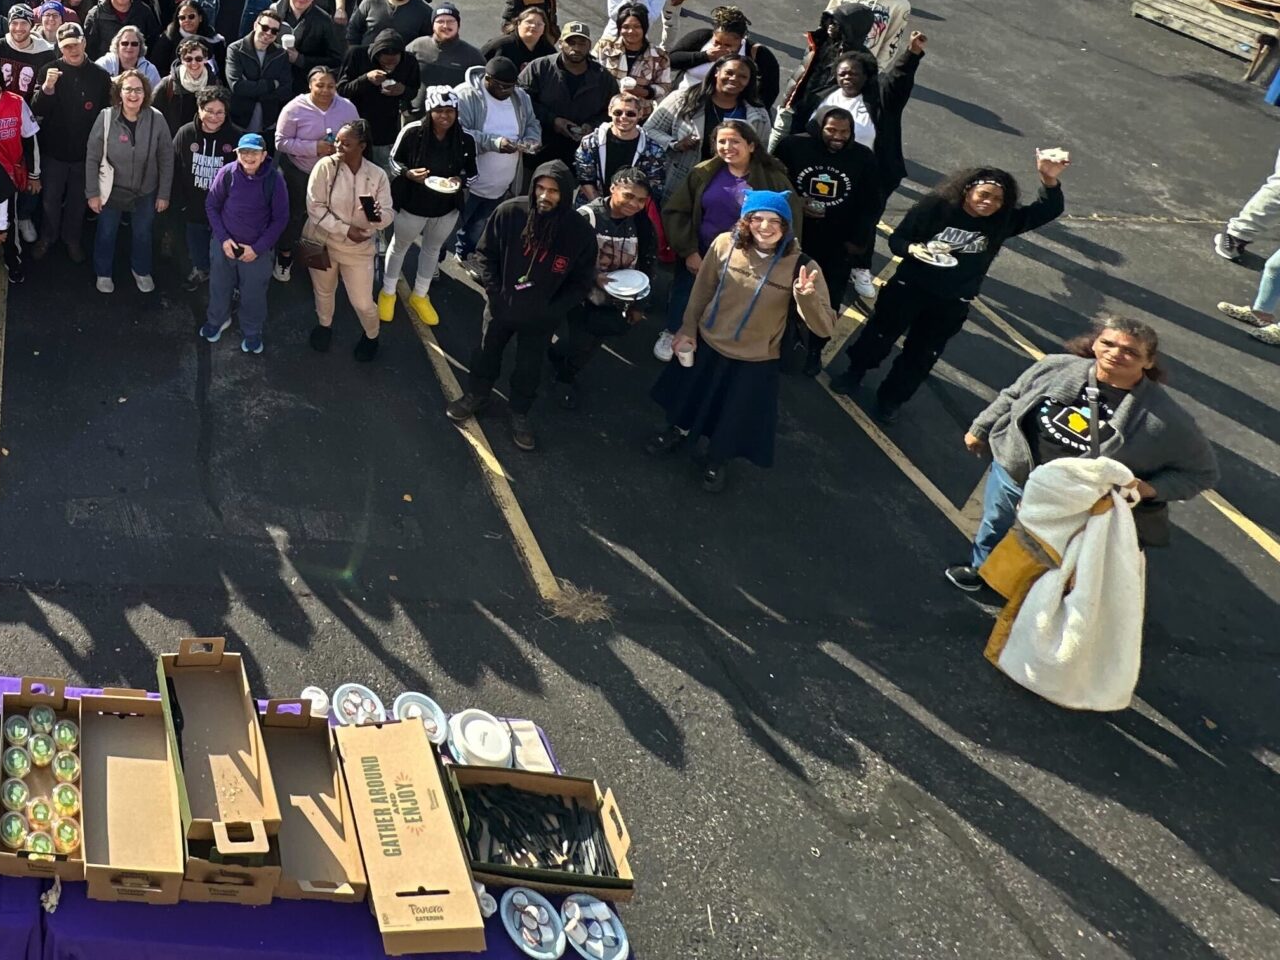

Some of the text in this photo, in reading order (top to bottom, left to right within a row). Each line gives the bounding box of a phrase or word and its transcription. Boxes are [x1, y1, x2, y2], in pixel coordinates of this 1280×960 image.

[360, 755, 402, 858] GATHER AROUND
[389, 792, 401, 815] AND
[394, 781, 423, 824] ENJOY
[408, 903, 444, 916] Panera
